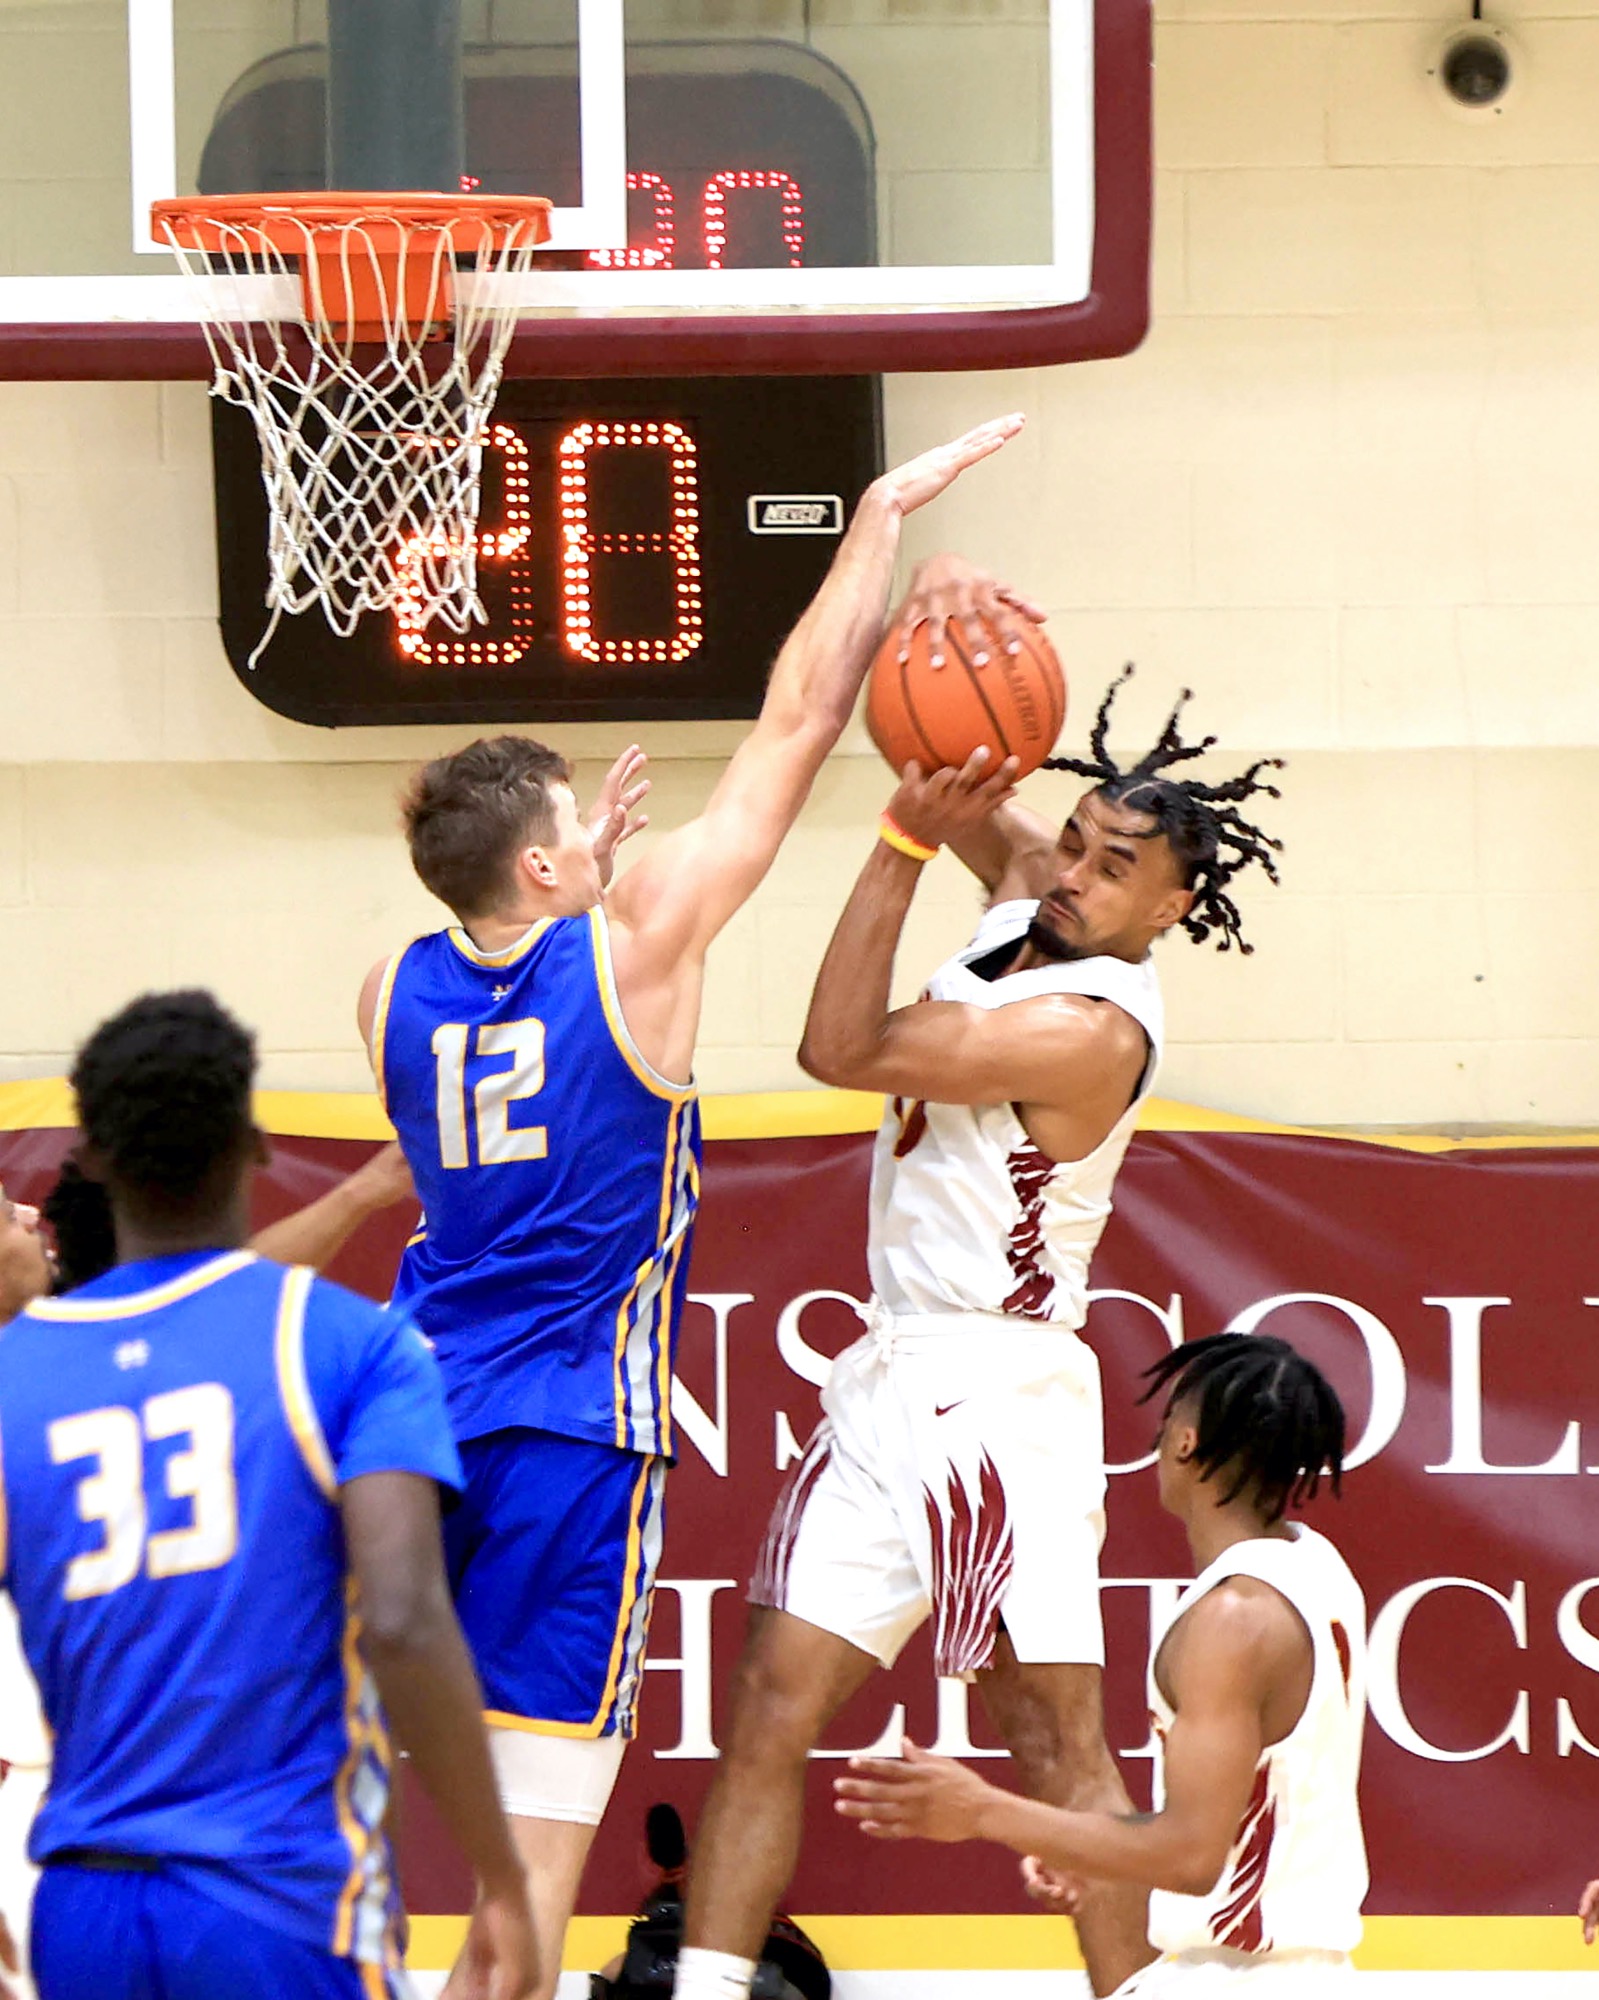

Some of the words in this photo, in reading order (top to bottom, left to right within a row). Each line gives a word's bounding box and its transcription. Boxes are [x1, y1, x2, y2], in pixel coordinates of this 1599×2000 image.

[398, 423, 703, 664] 20
[431, 1017, 548, 1169] 12
[47, 1381, 239, 1602] 33
